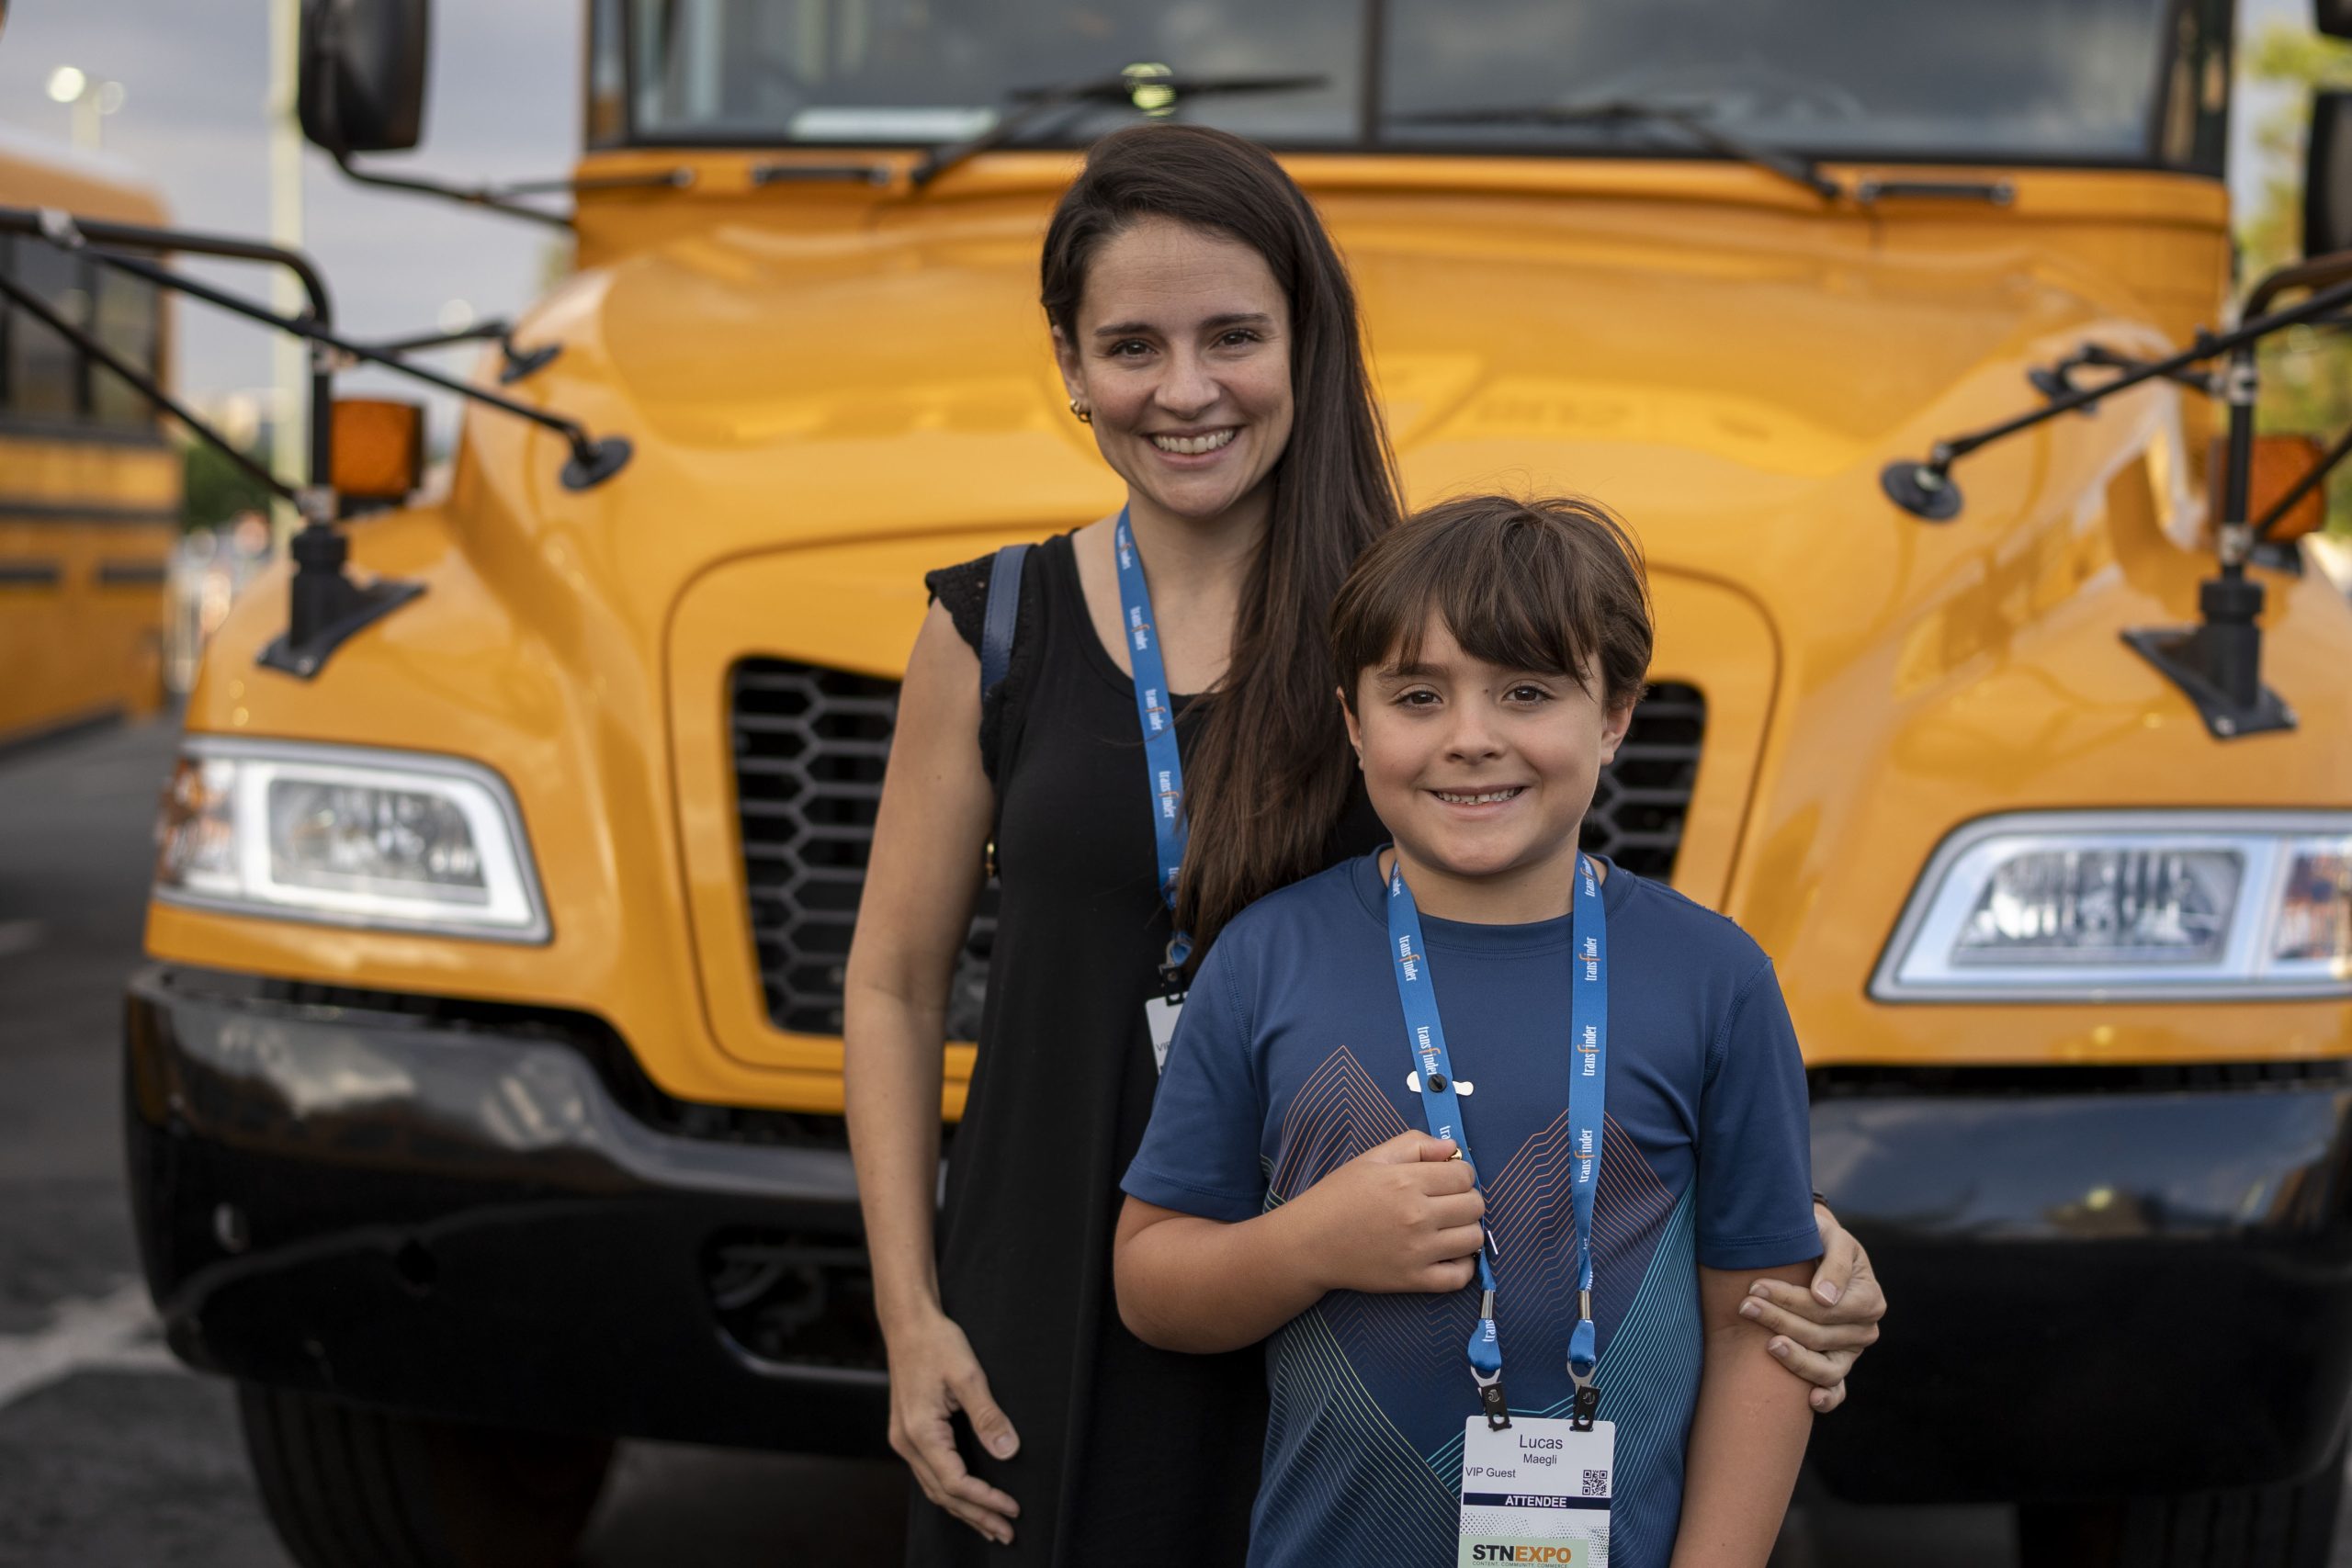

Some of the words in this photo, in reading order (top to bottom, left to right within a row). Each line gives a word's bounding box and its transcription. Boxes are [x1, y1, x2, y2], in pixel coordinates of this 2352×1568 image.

[1159, 771, 1179, 818] transfinder
[1398, 935, 1420, 982] transfinder
[1578, 937, 1601, 982] transfinder
[1577, 1025, 1600, 1076] transfinder
[1574, 1128, 1595, 1183] transfinder
[1519, 1434, 1564, 1450] Lucas
[1523, 1453, 1557, 1467] Maegli
[1465, 1467, 1484, 1477] VIP
[1486, 1468, 1516, 1478] Guest
[1505, 1495, 1567, 1508] ATTENDEE
